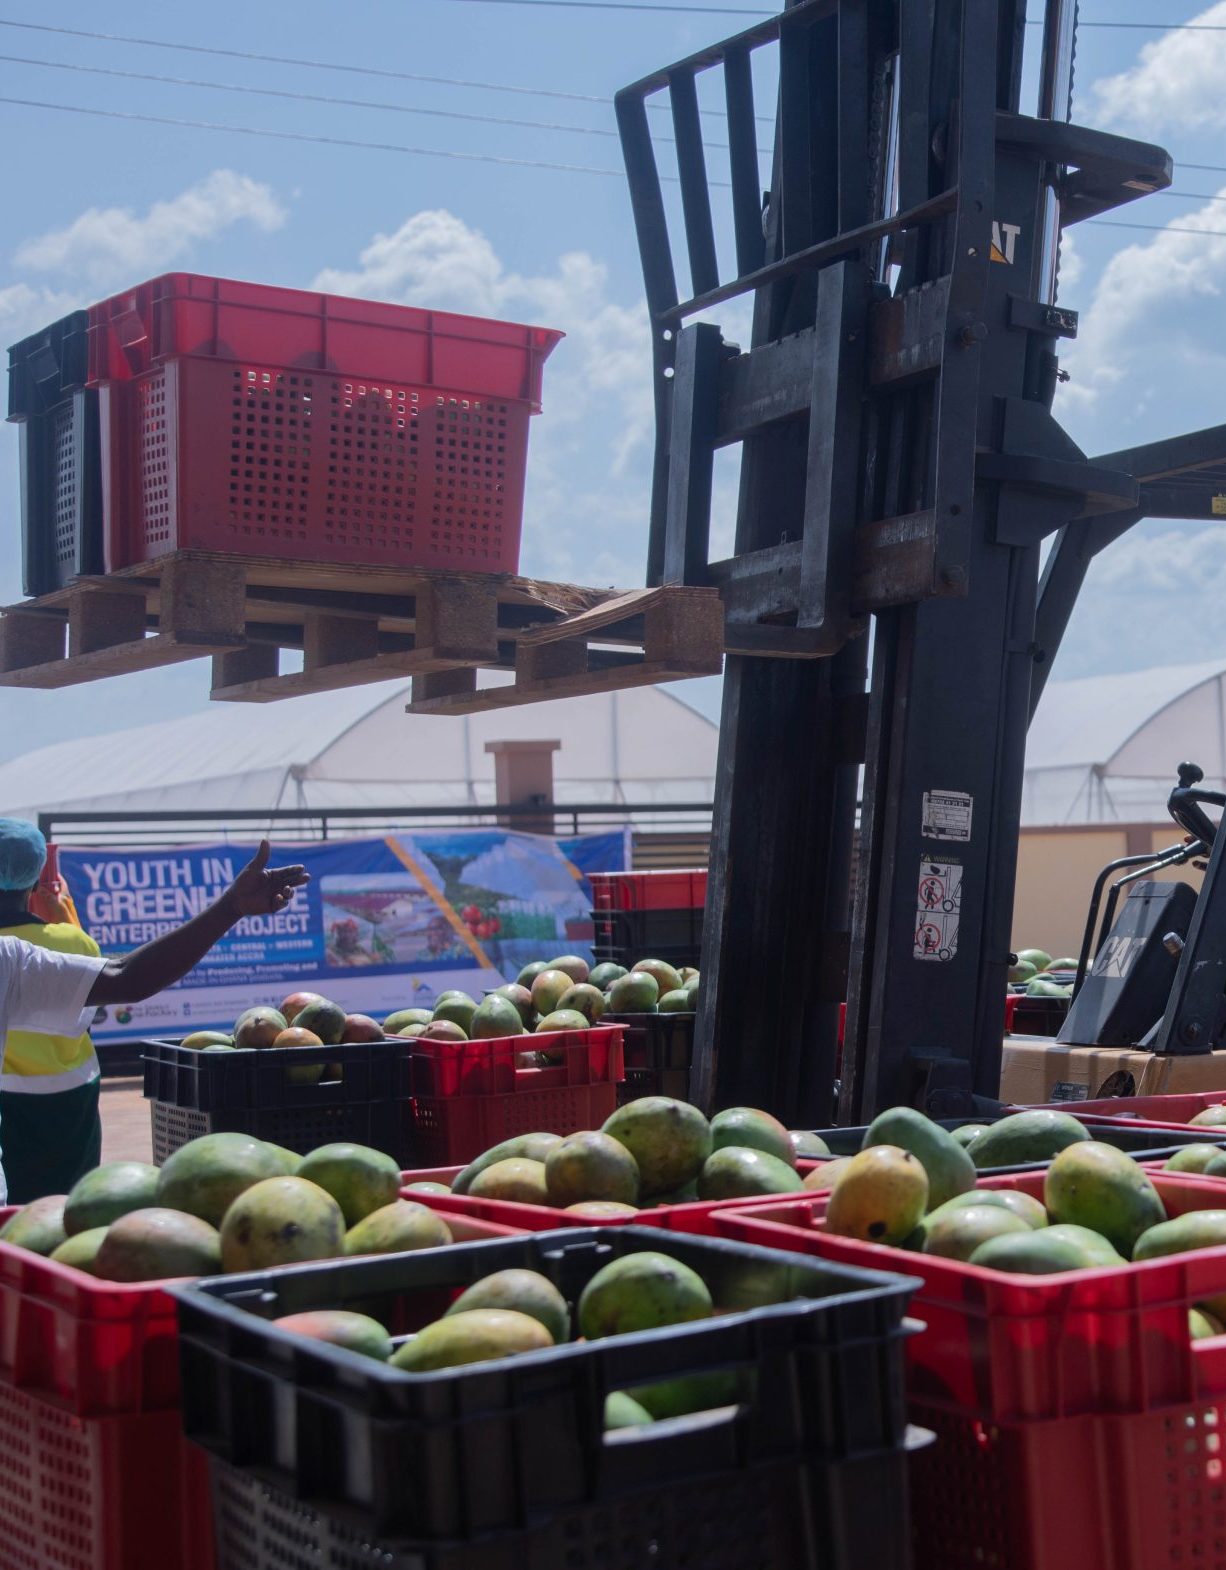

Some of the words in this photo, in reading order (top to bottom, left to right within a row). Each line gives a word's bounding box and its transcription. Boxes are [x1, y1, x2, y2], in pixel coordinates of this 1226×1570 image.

[990, 220, 1021, 264] AT
[82, 858, 192, 890] YOUTH
[202, 857, 234, 885] IN
[86, 884, 310, 923] GREENHE
[224, 913, 311, 937] ROJECT
[1091, 935, 1148, 978] CAT
